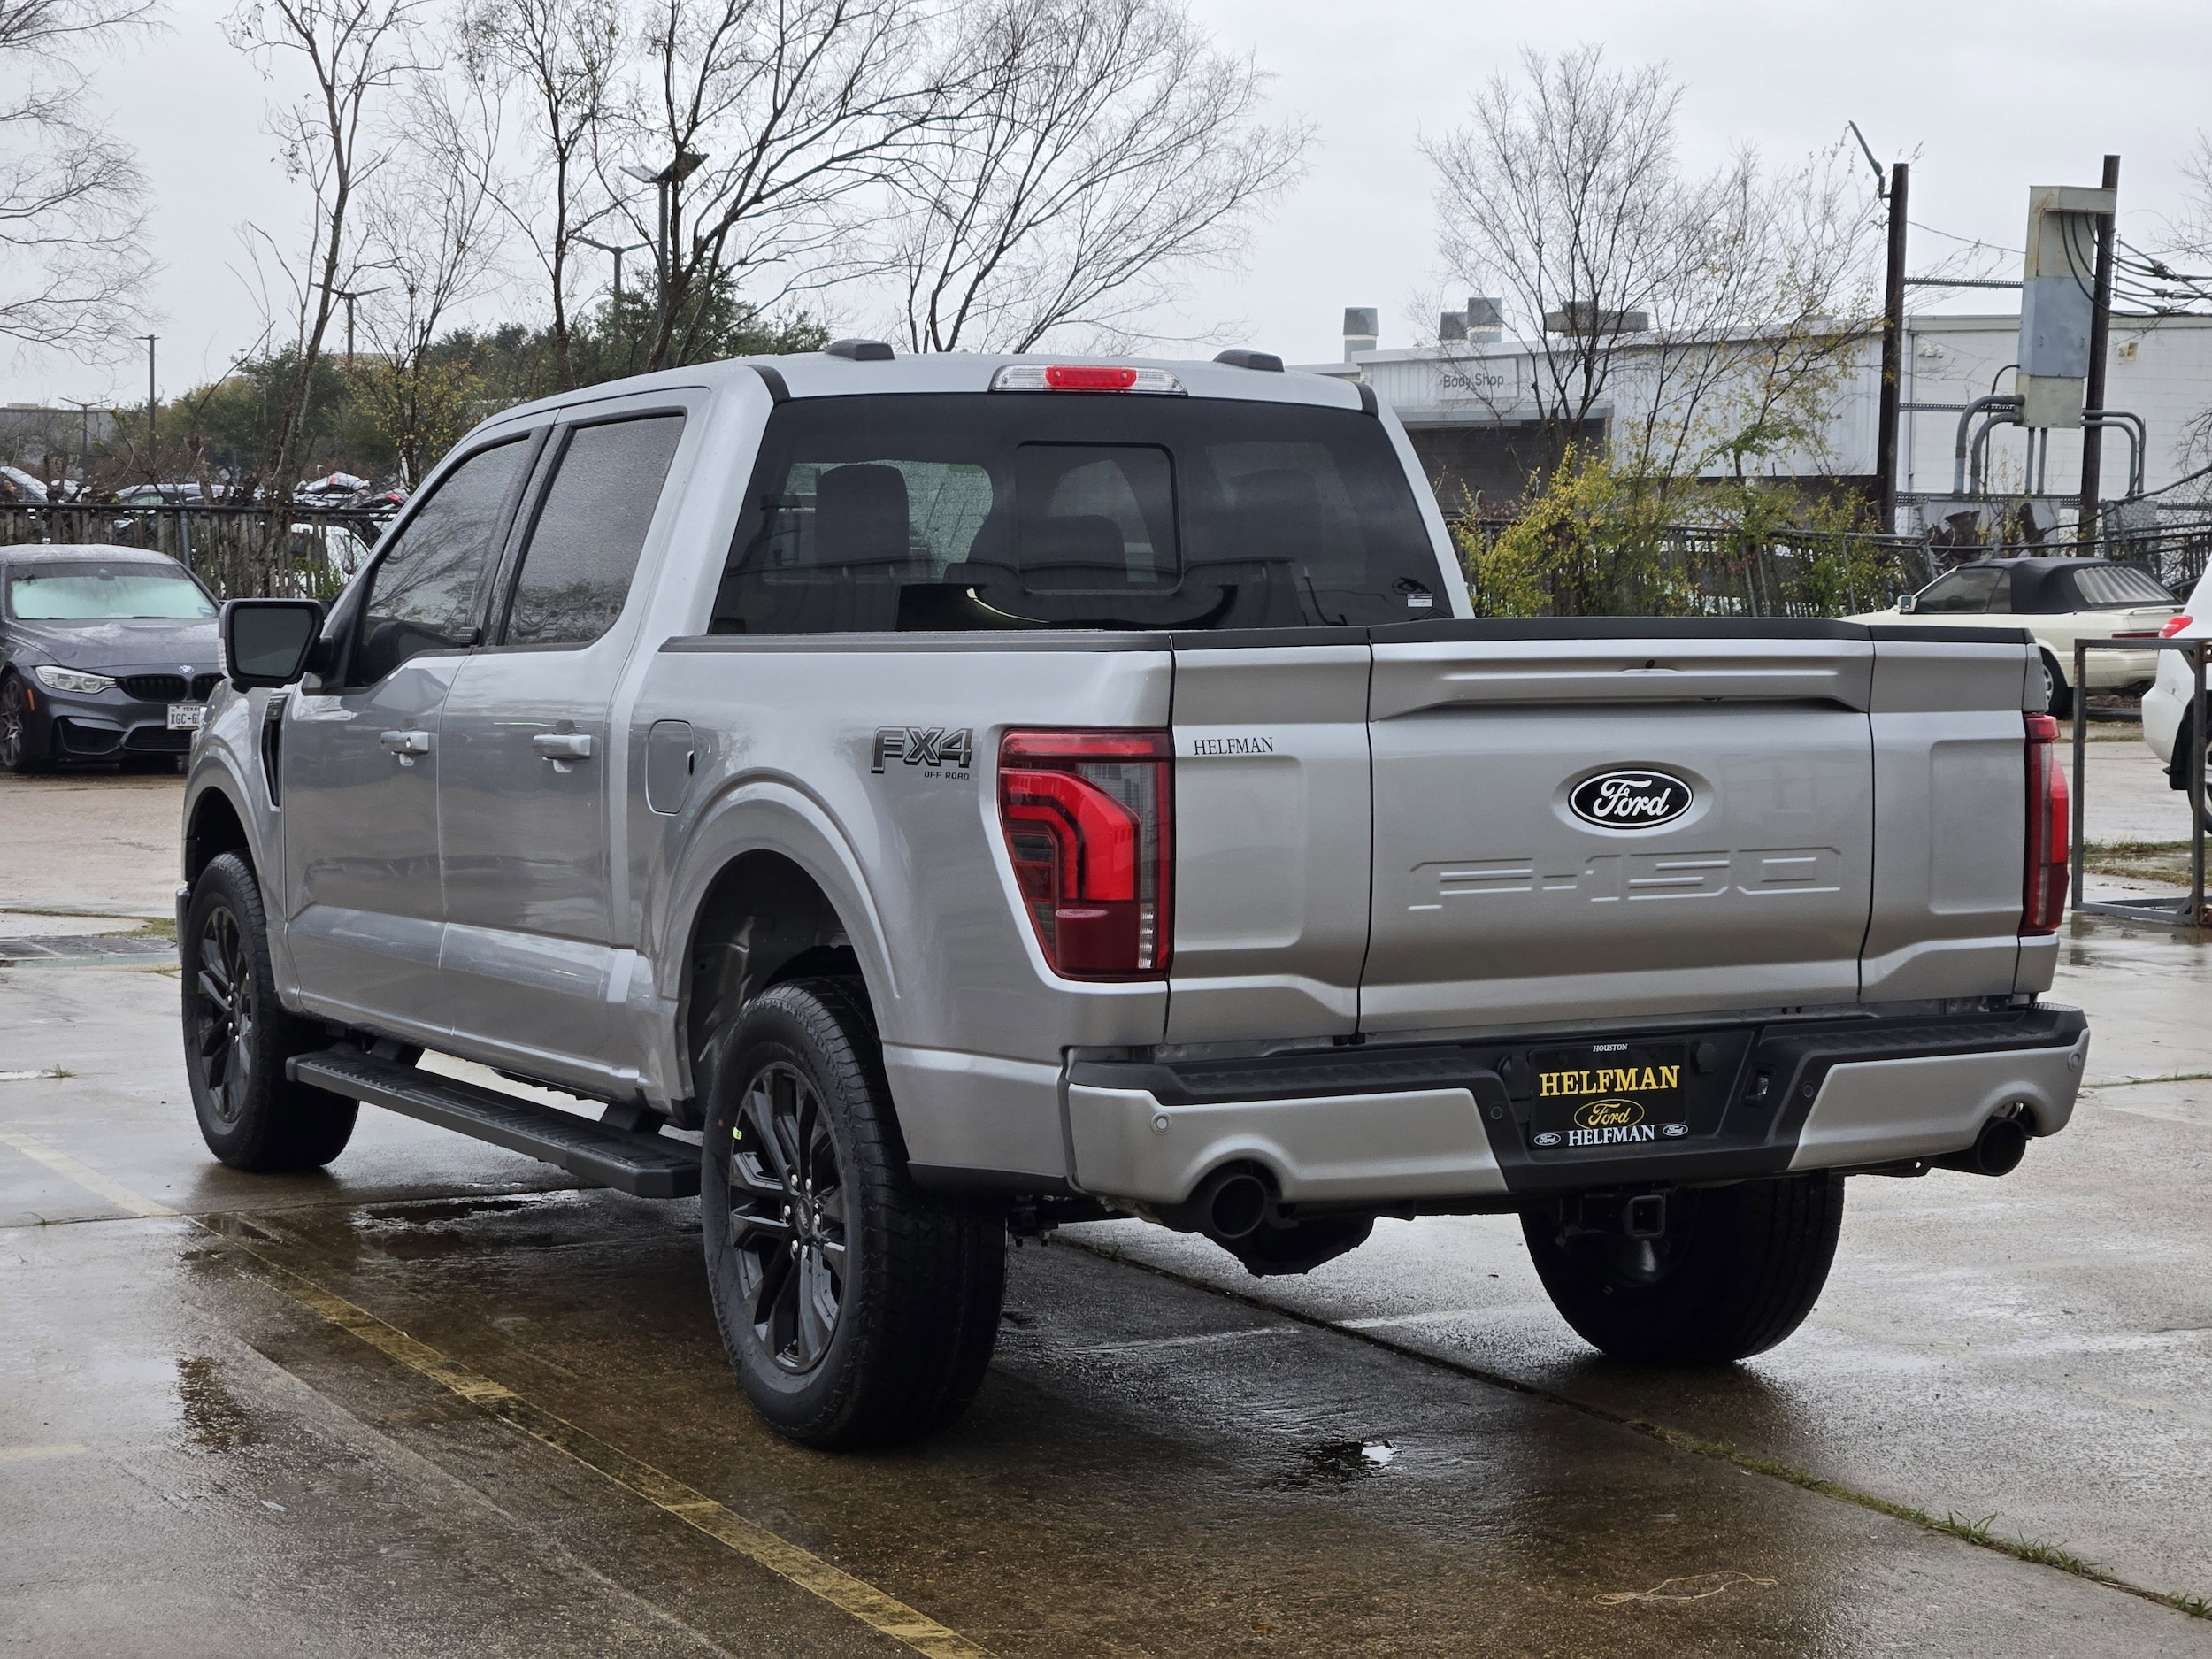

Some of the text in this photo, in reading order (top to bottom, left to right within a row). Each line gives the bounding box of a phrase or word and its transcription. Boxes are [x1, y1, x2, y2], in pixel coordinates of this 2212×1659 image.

[1443, 373, 1504, 389] Body Shop
[171, 713, 200, 725] XGC-6
[871, 726, 973, 774] FX4
[1194, 737, 1273, 755] HELFMAN
[1593, 779, 1670, 818] Ford
[1409, 847, 1841, 910] F-150
[1593, 1043, 1628, 1053] HOUSTON
[1539, 1065, 1680, 1096] HELFMAN
[1588, 1103, 1631, 1125] Ford
[1567, 1124, 1655, 1146] HELFMAN
